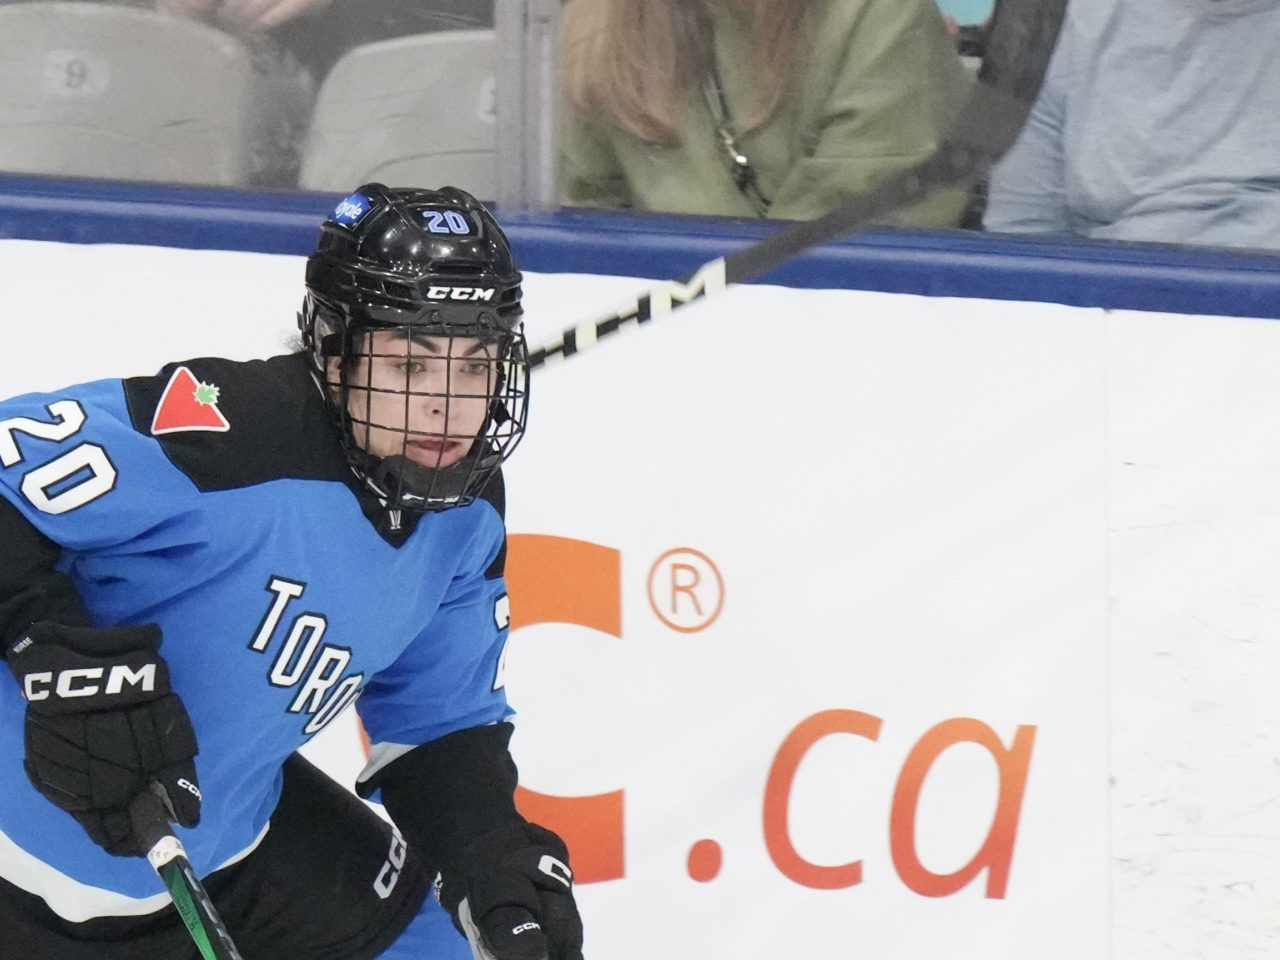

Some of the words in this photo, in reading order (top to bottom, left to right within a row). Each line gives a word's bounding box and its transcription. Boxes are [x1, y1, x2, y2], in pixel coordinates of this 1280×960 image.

[423, 210, 470, 234] 20
[427, 286, 495, 301] CCM
[24, 663, 157, 701] CCM
